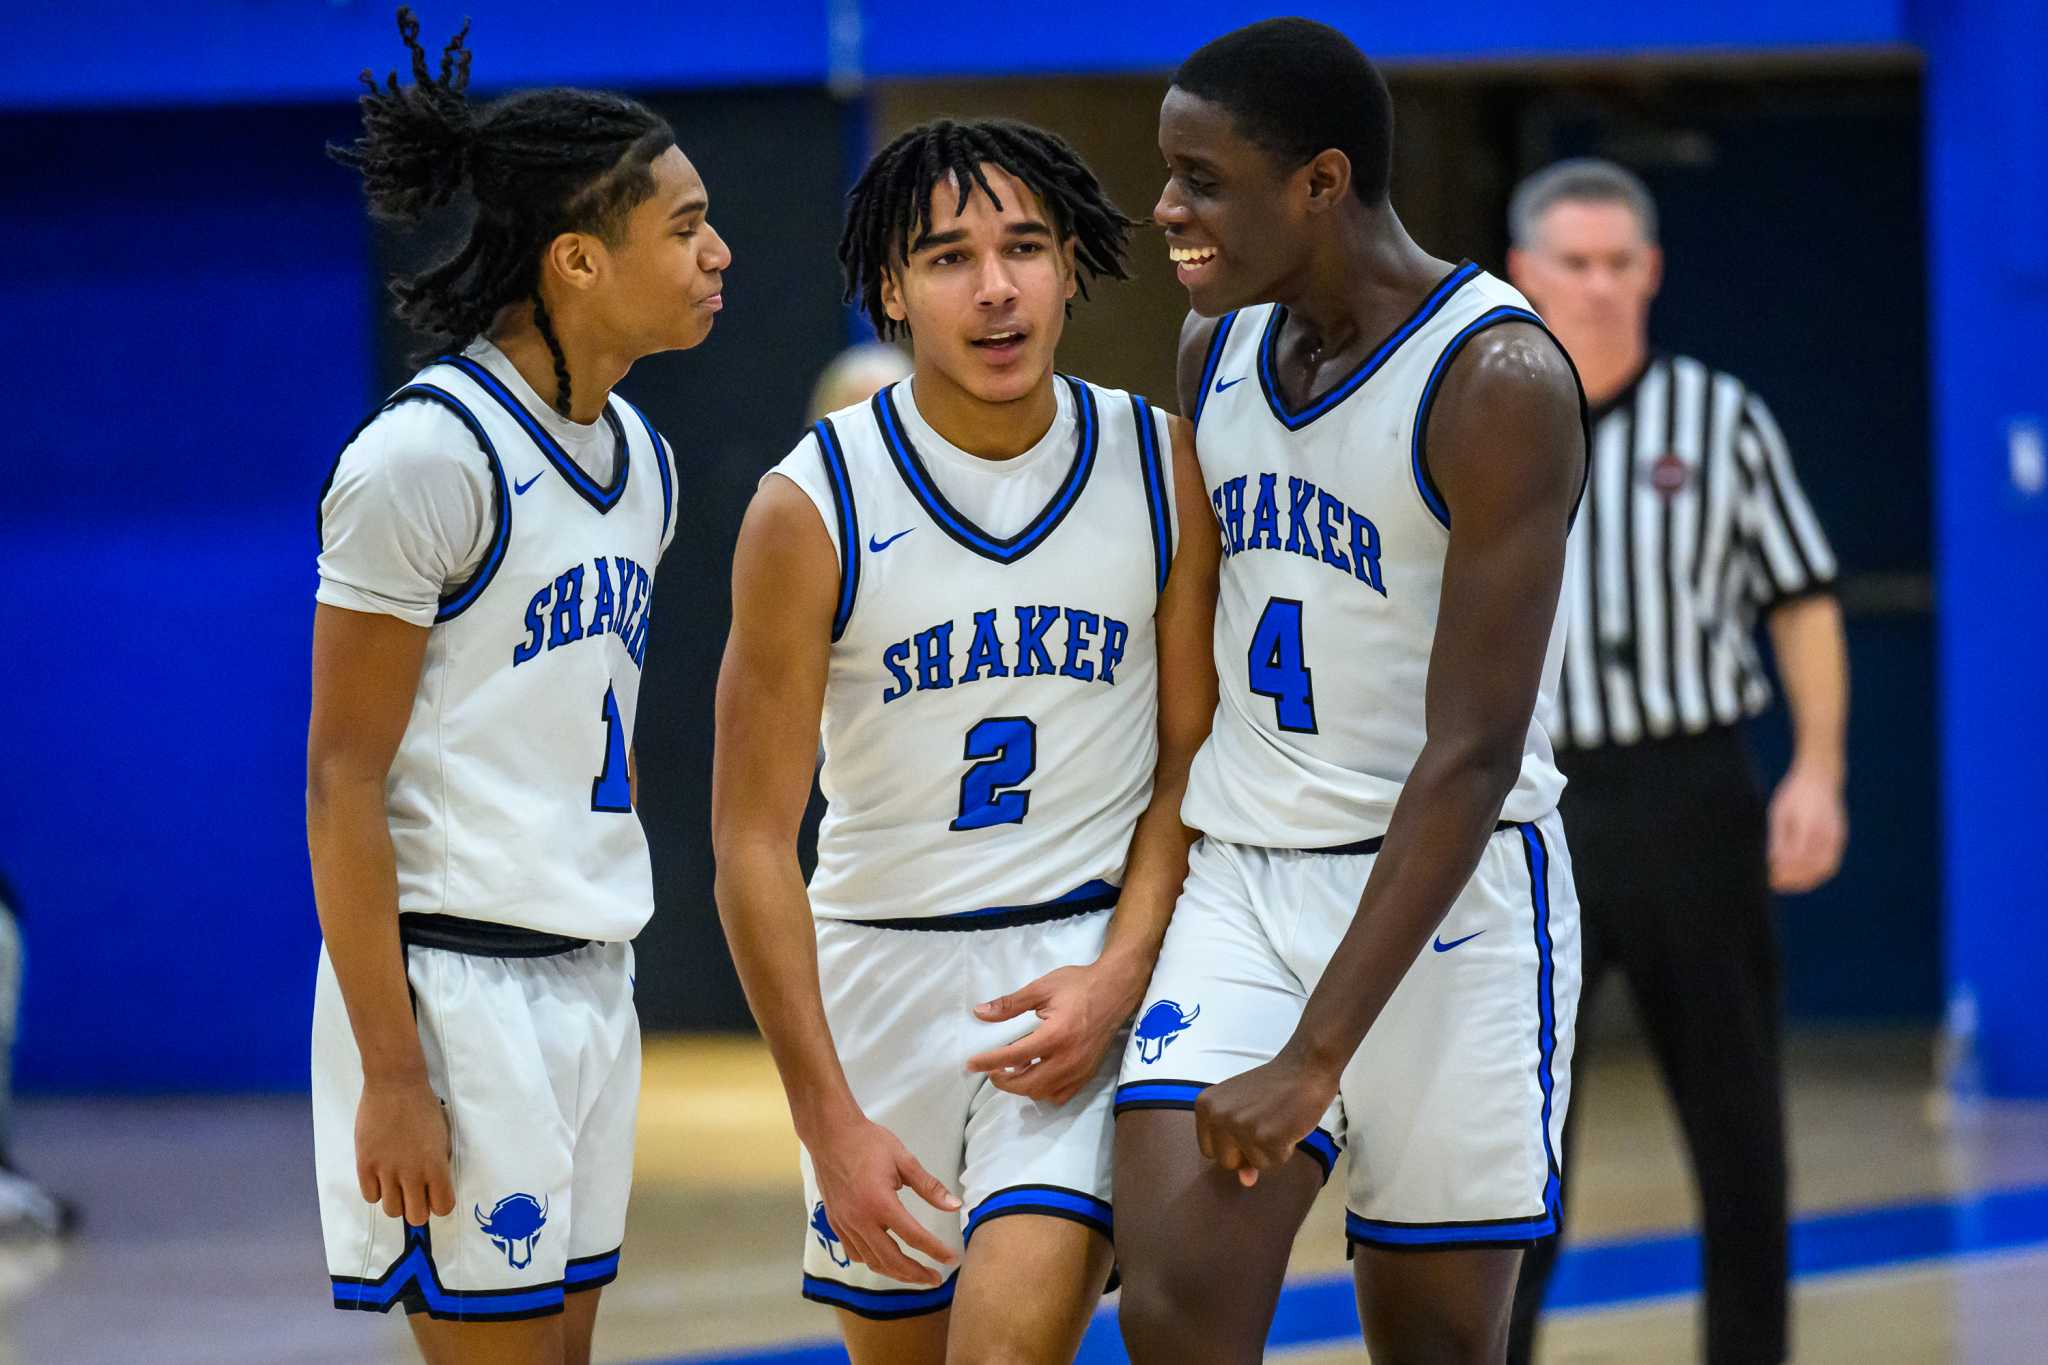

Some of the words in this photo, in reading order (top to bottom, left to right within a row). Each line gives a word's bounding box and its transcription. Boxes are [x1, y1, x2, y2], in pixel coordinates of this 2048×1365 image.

[883, 605, 1128, 704] SHAKER
[1248, 596, 1319, 735] 4
[591, 678, 632, 814] 1
[948, 716, 1037, 831] 2
